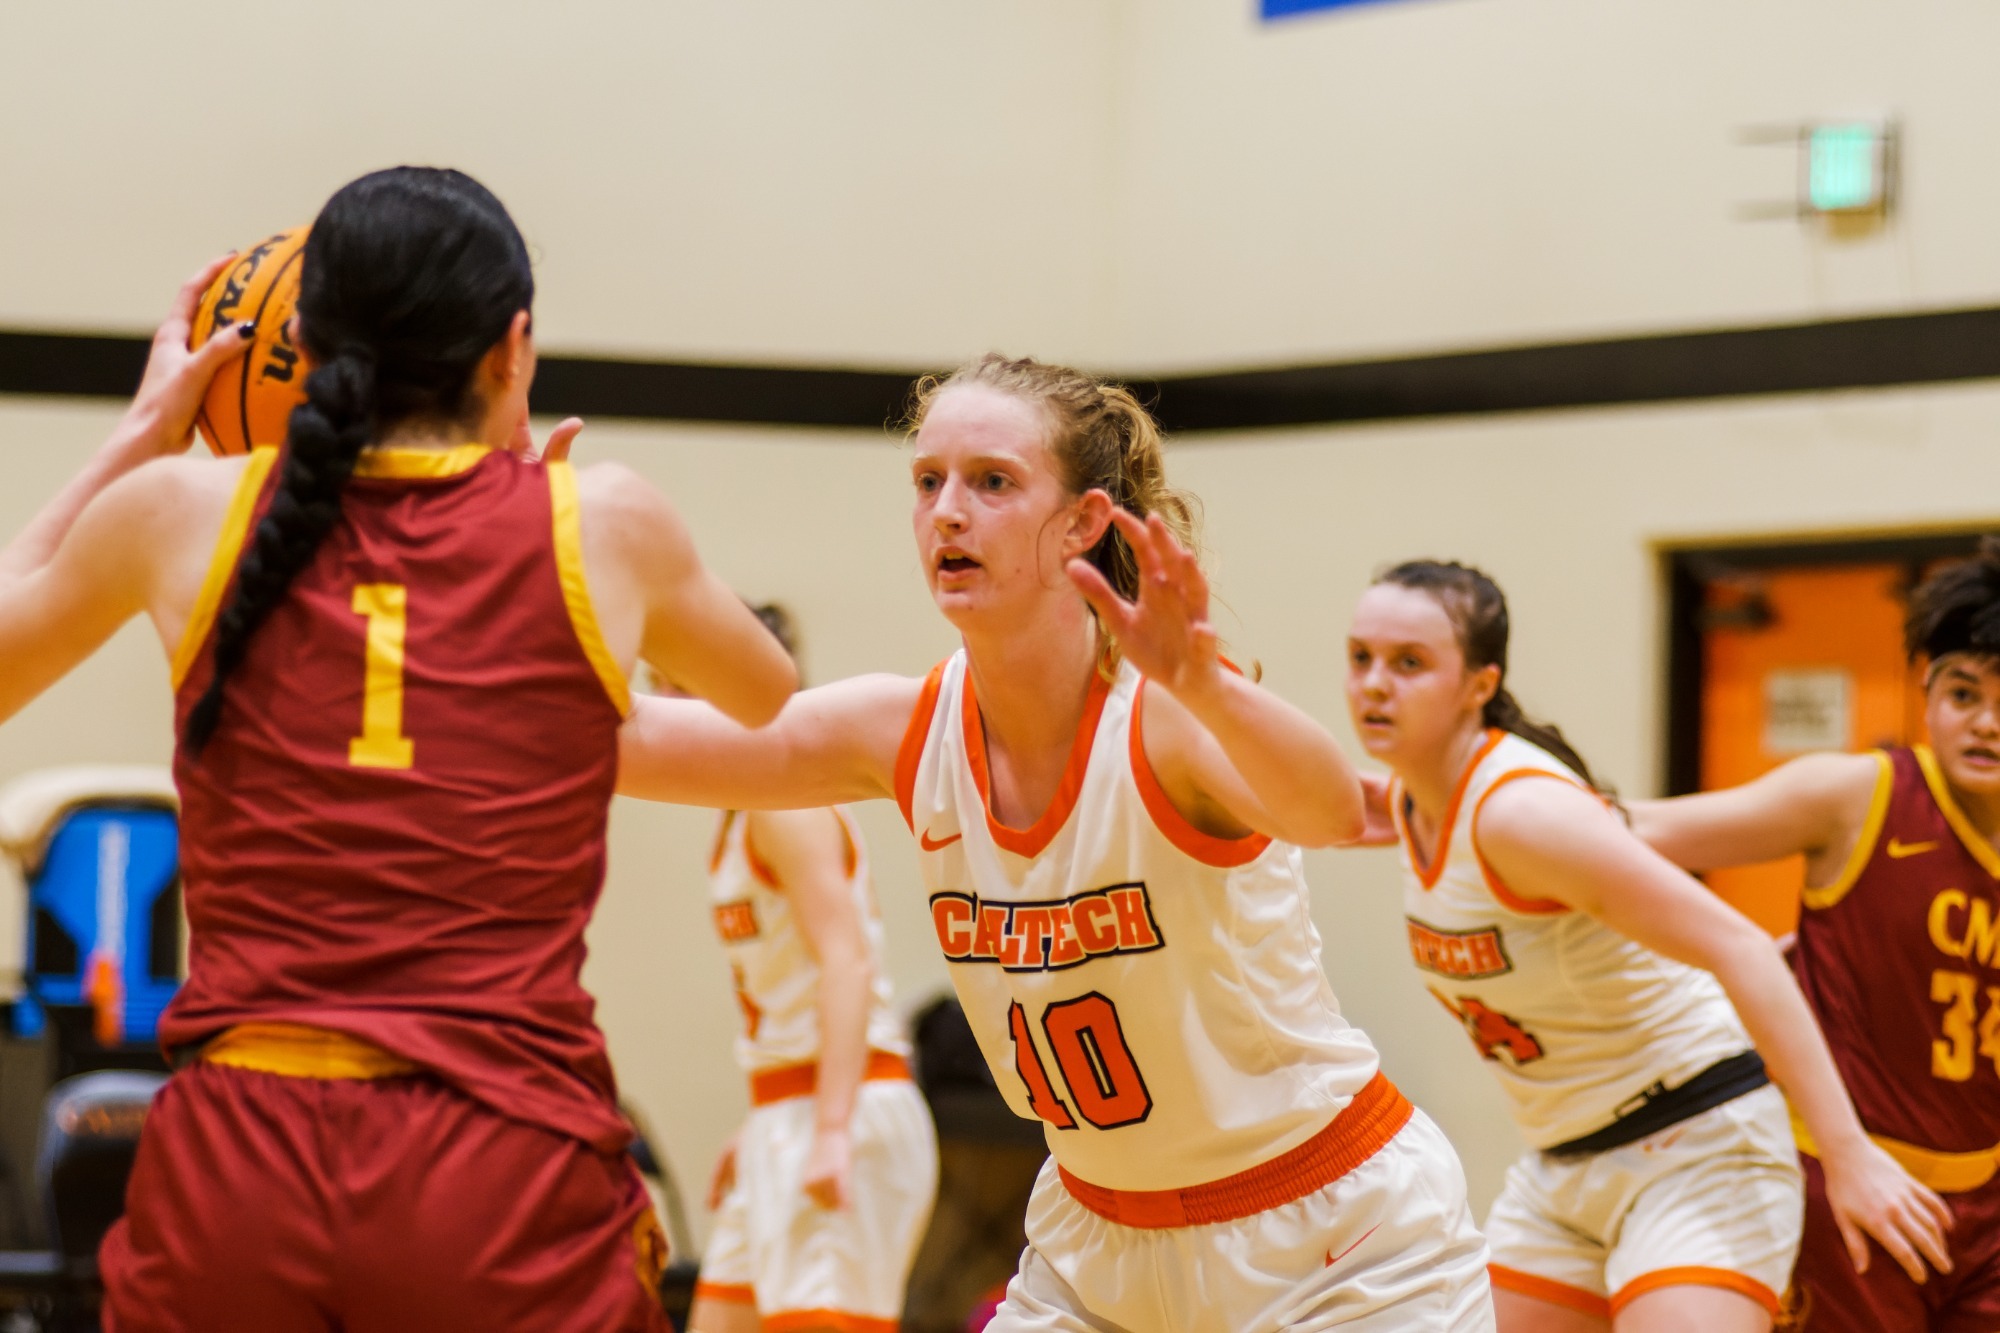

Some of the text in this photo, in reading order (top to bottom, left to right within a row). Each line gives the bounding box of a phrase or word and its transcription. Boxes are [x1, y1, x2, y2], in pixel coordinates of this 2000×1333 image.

[349, 583, 414, 769] 1
[929, 881, 1166, 973] CALTECH
[1406, 917, 1513, 980] TECH
[1007, 991, 1153, 1130] 10
